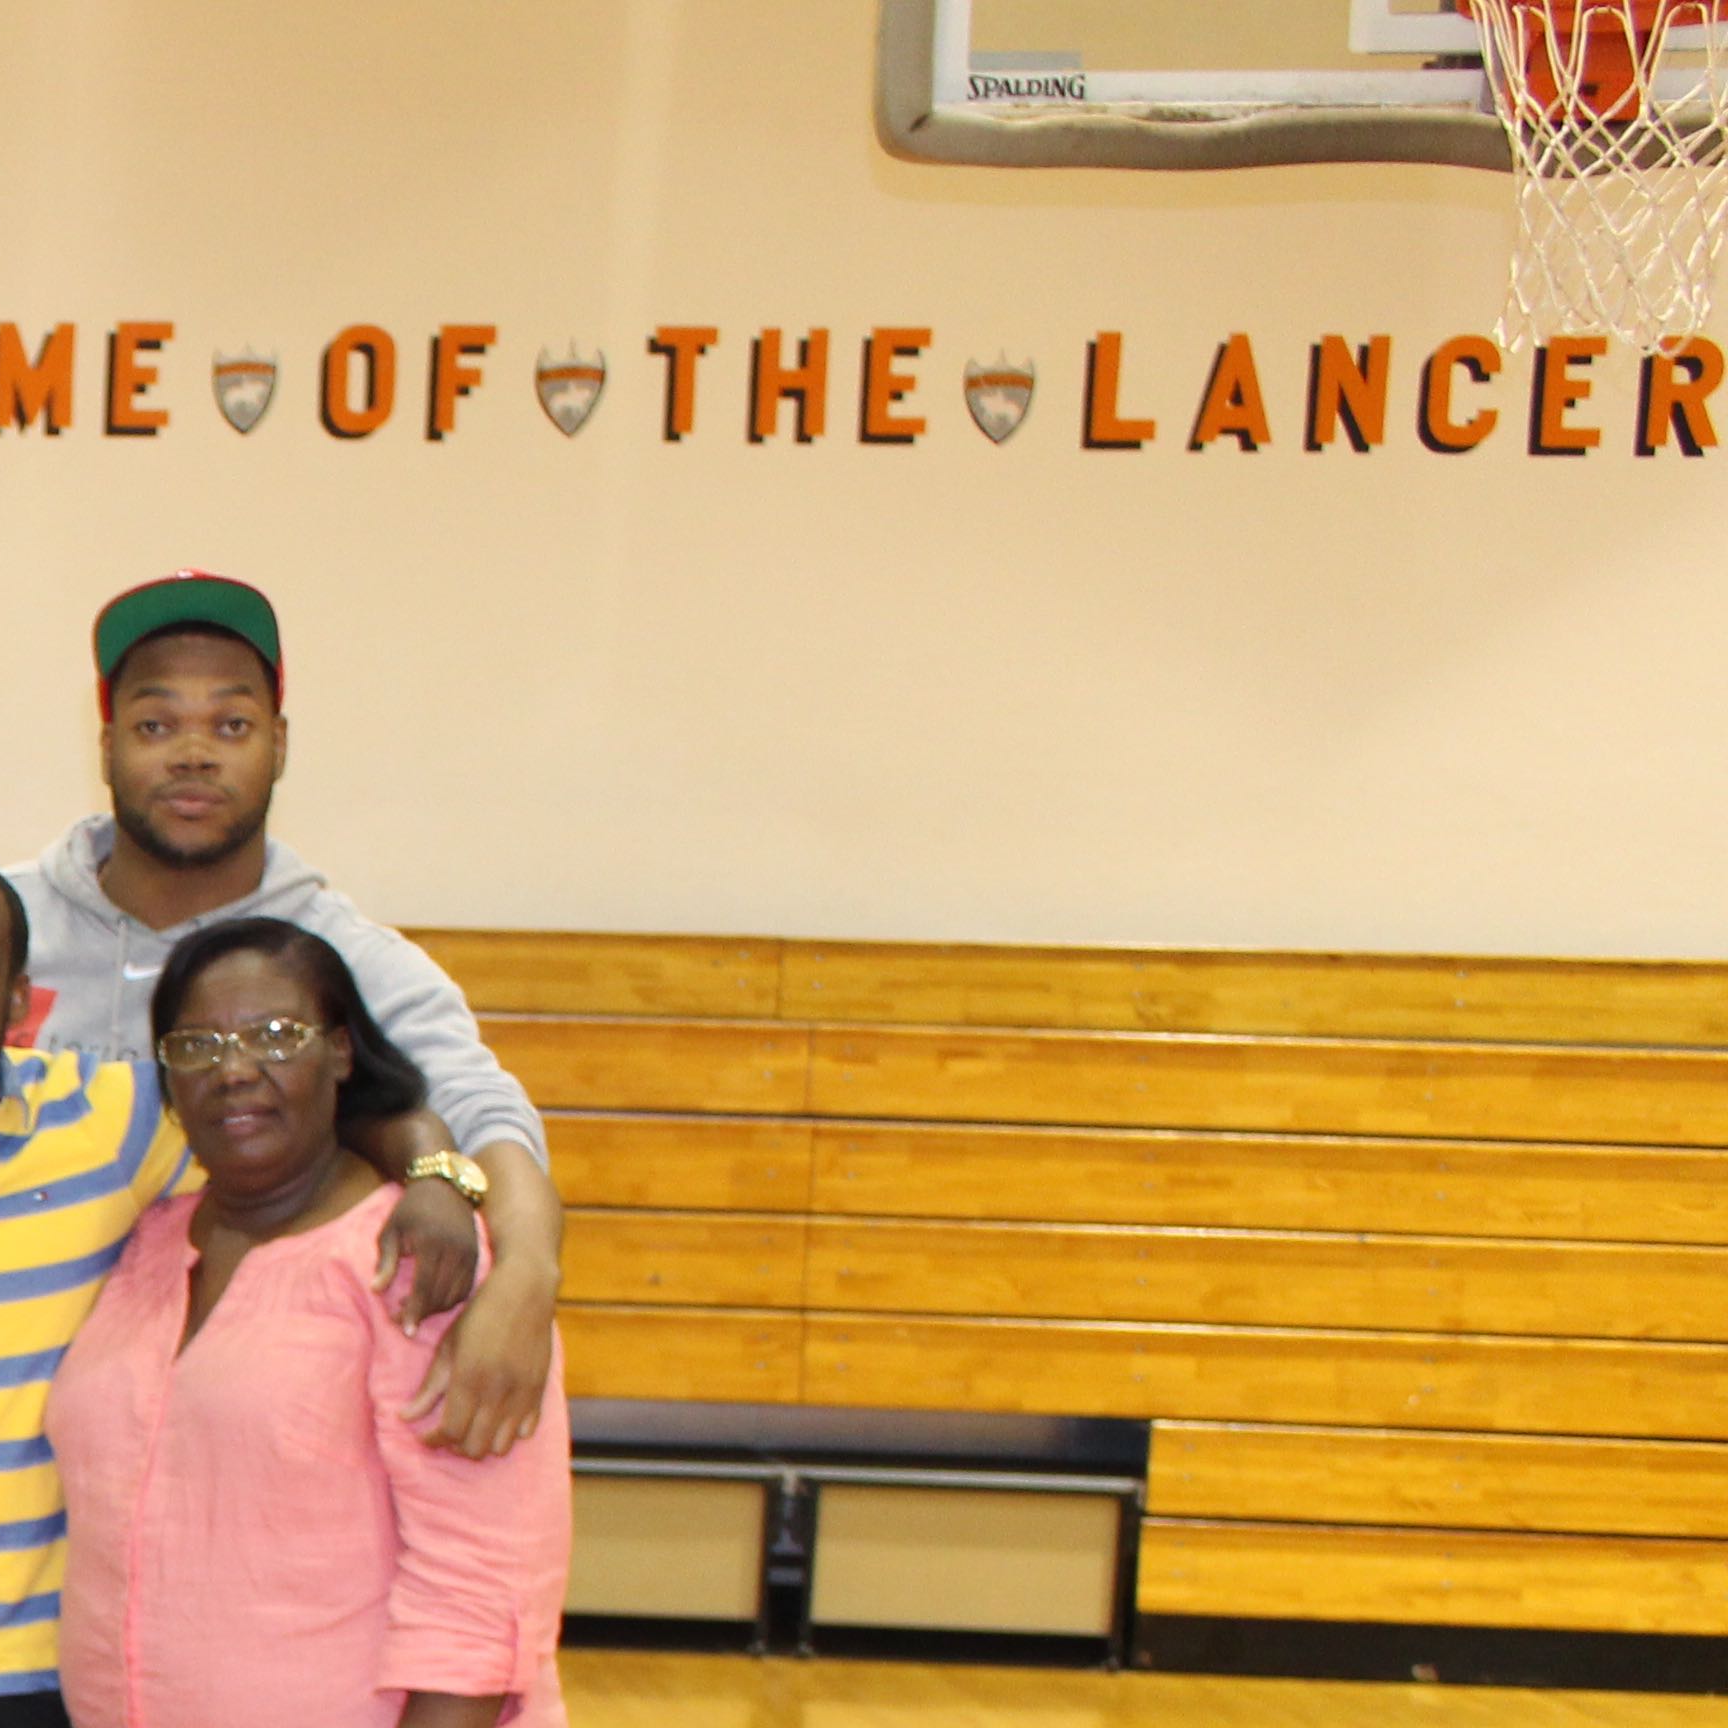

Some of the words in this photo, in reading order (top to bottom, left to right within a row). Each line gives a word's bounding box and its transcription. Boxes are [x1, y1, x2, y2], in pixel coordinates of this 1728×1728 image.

[967, 74, 1087, 101] SPALDING
[318, 323, 498, 441] OF
[647, 326, 933, 444] THE
[1081, 330, 1725, 458] LANCER
